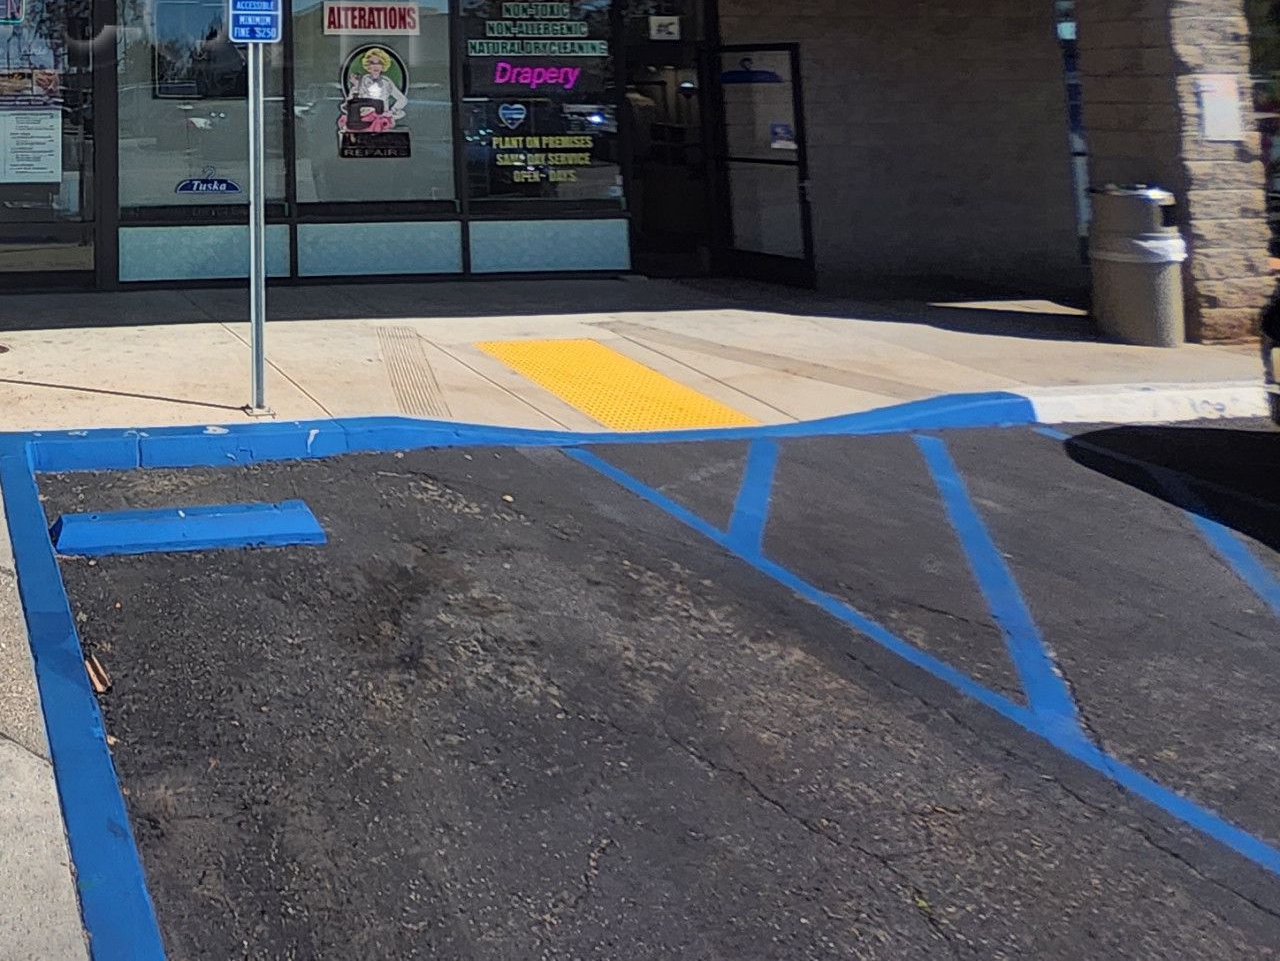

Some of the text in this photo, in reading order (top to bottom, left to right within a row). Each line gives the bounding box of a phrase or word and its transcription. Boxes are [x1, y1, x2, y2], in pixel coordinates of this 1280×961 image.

[236, 0, 274, 10] ACCESSIBLE
[503, 2, 570, 18] NON-TOXIC
[239, 15, 271, 26] MINIMUM
[327, 5, 417, 30] ALTERATIONS
[234, 26, 277, 39] FINE $250
[486, 21, 588, 37] NON-ALLERGENIC
[494, 62, 580, 89] Drapery
[492, 135, 594, 149] PLANT ON PREMISES
[527, 153, 546, 165] DAY
[547, 152, 592, 165] SERVICE
[548, 169, 577, 182] DAYS
[191, 179, 228, 192] Tuska
